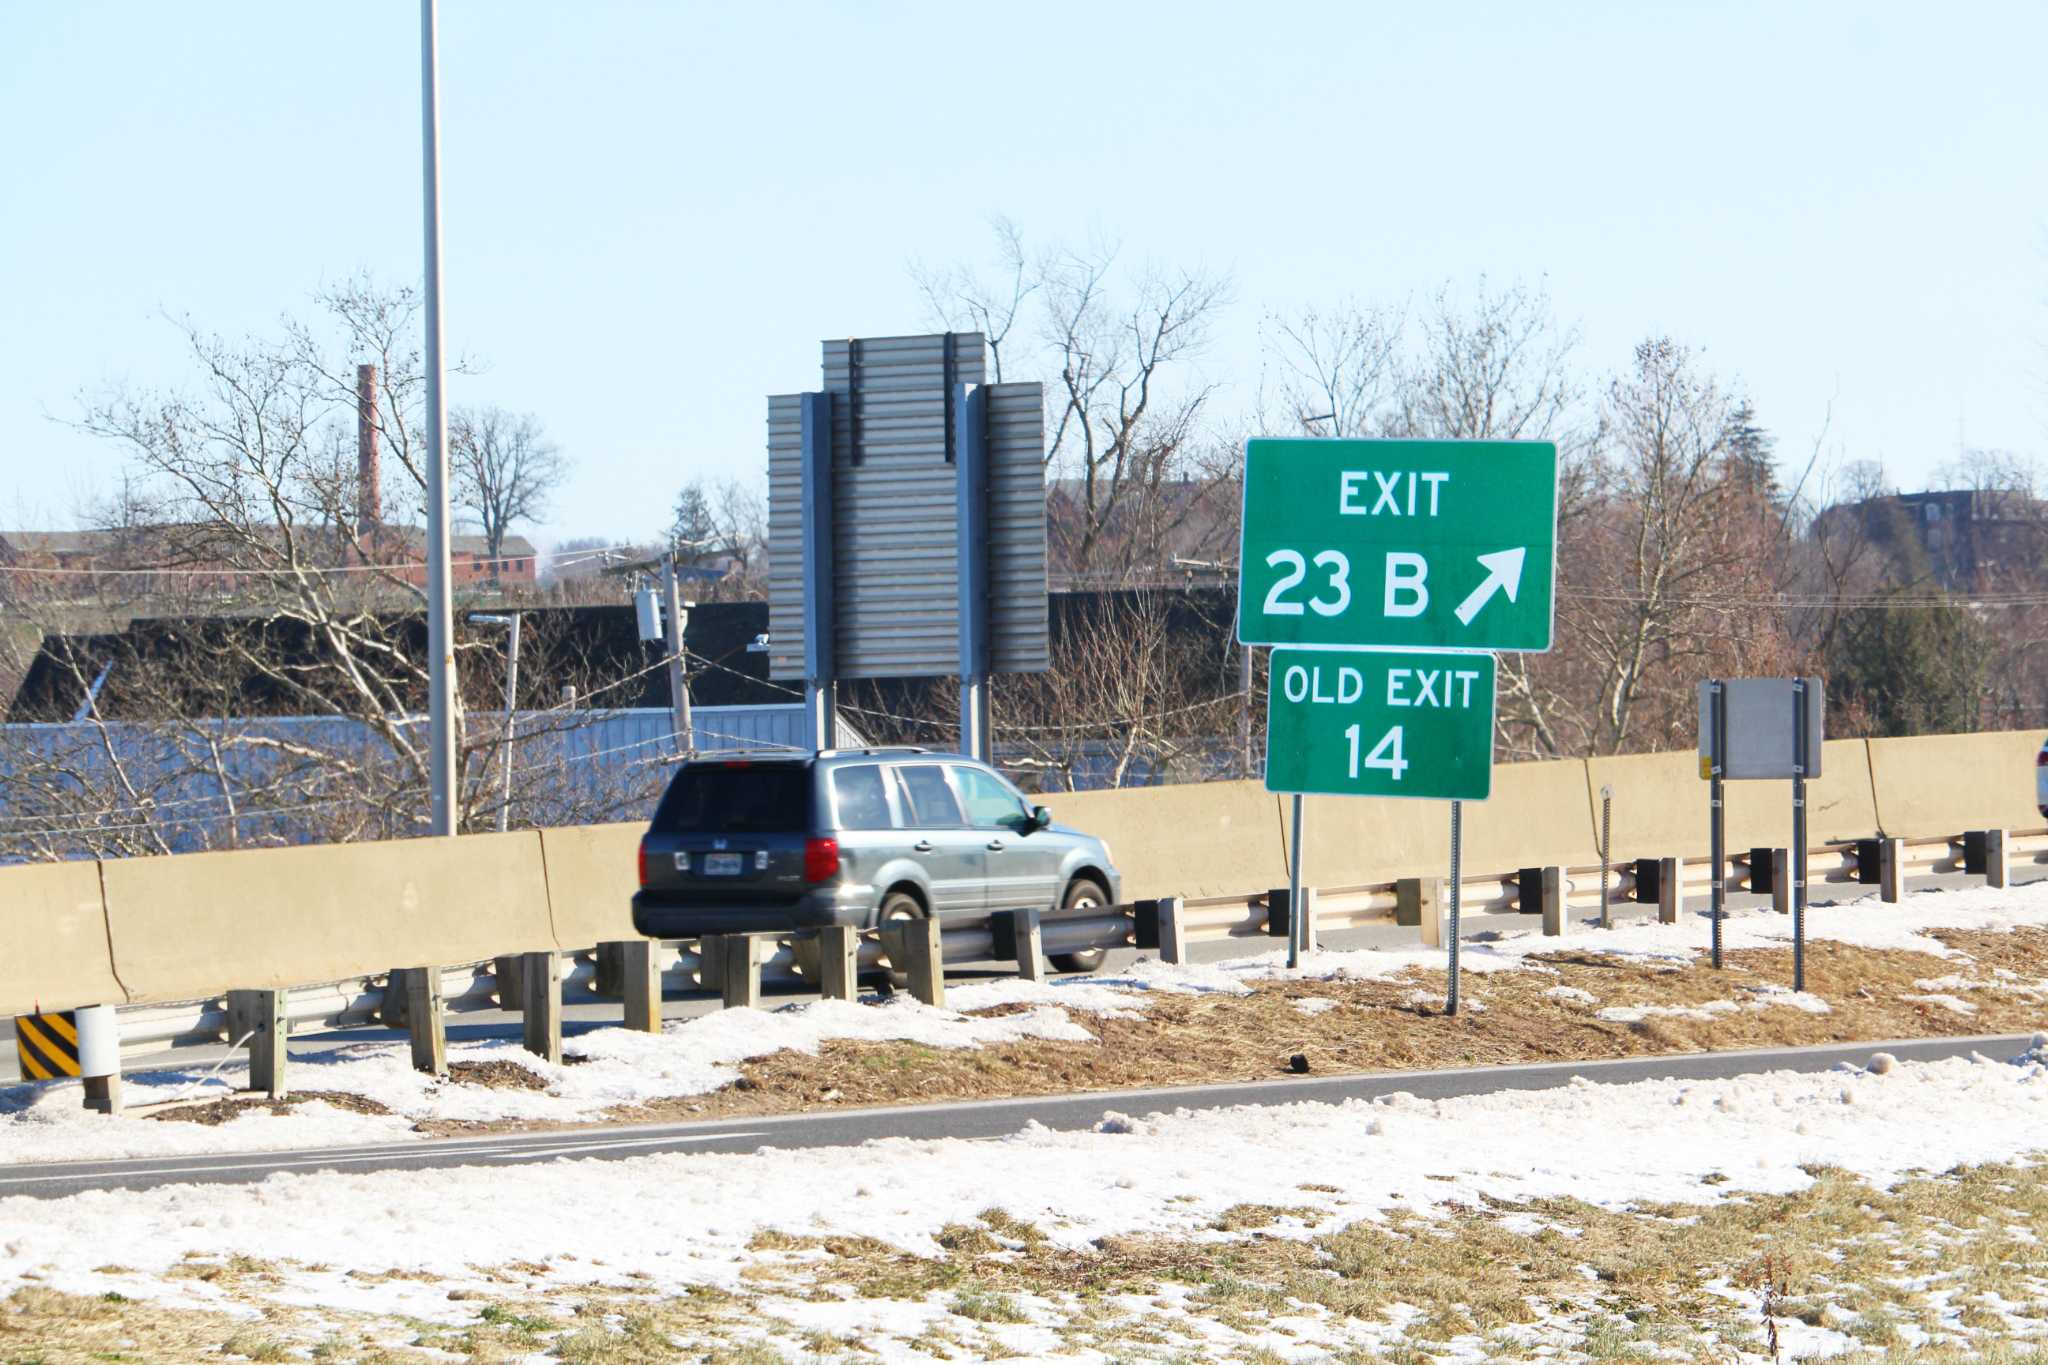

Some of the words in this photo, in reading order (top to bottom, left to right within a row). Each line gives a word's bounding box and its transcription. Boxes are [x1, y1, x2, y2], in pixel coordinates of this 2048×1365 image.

[1340, 471, 1449, 516] EXIT
[1263, 549, 1351, 616] 23
[1384, 552, 1429, 617] B
[1284, 665, 1363, 704] OLD
[1387, 669, 1479, 708] EXIT
[1345, 724, 1408, 780] 14
